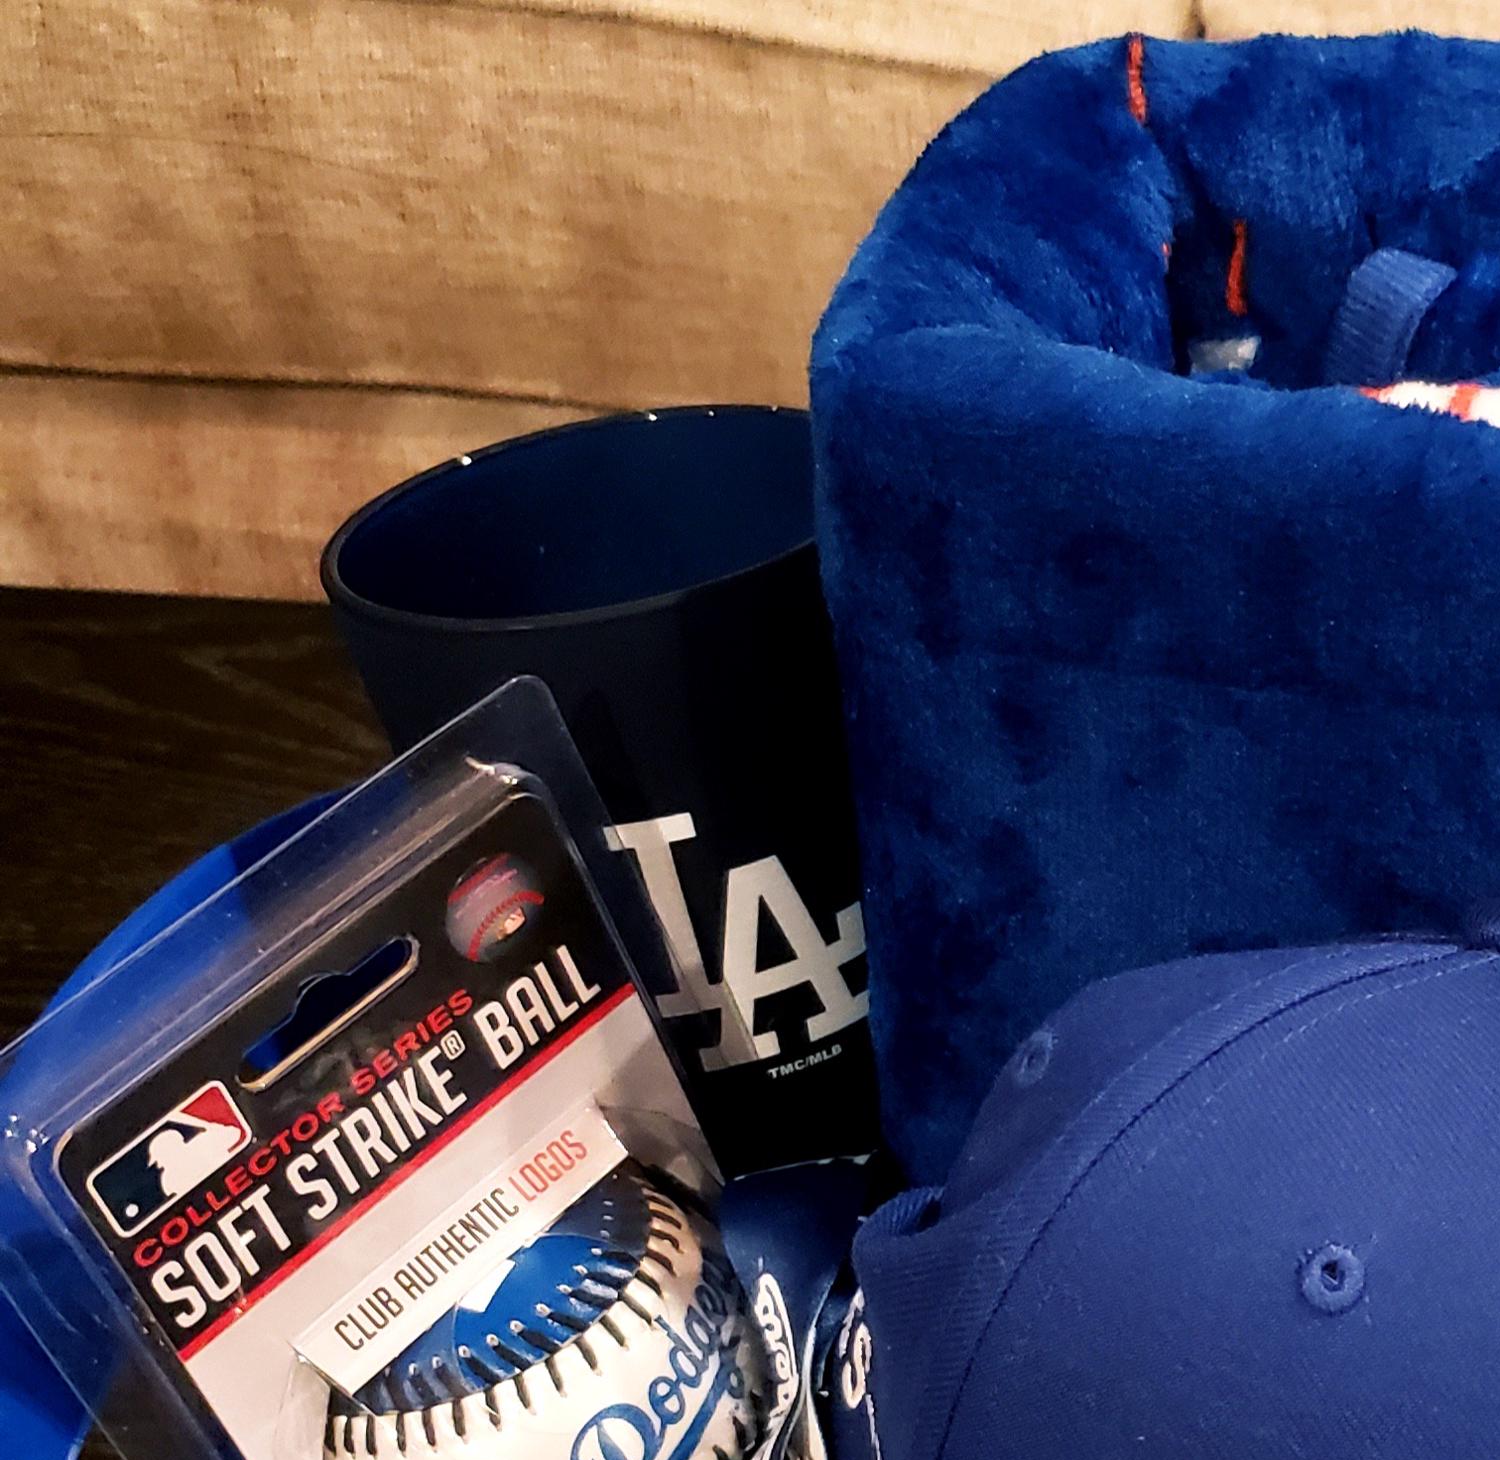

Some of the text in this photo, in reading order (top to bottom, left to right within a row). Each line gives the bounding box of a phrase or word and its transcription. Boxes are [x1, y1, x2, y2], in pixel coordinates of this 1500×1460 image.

[603, 812, 870, 1072] LA
[767, 1043, 843, 1080] TMC/MLB
[133, 988, 474, 1268] COLLECTOR SERIES
[149, 1182, 294, 1330] SOFT
[473, 944, 601, 1070] BALL
[333, 1129, 589, 1352] CLUB AUTHENTIC LOGOS
